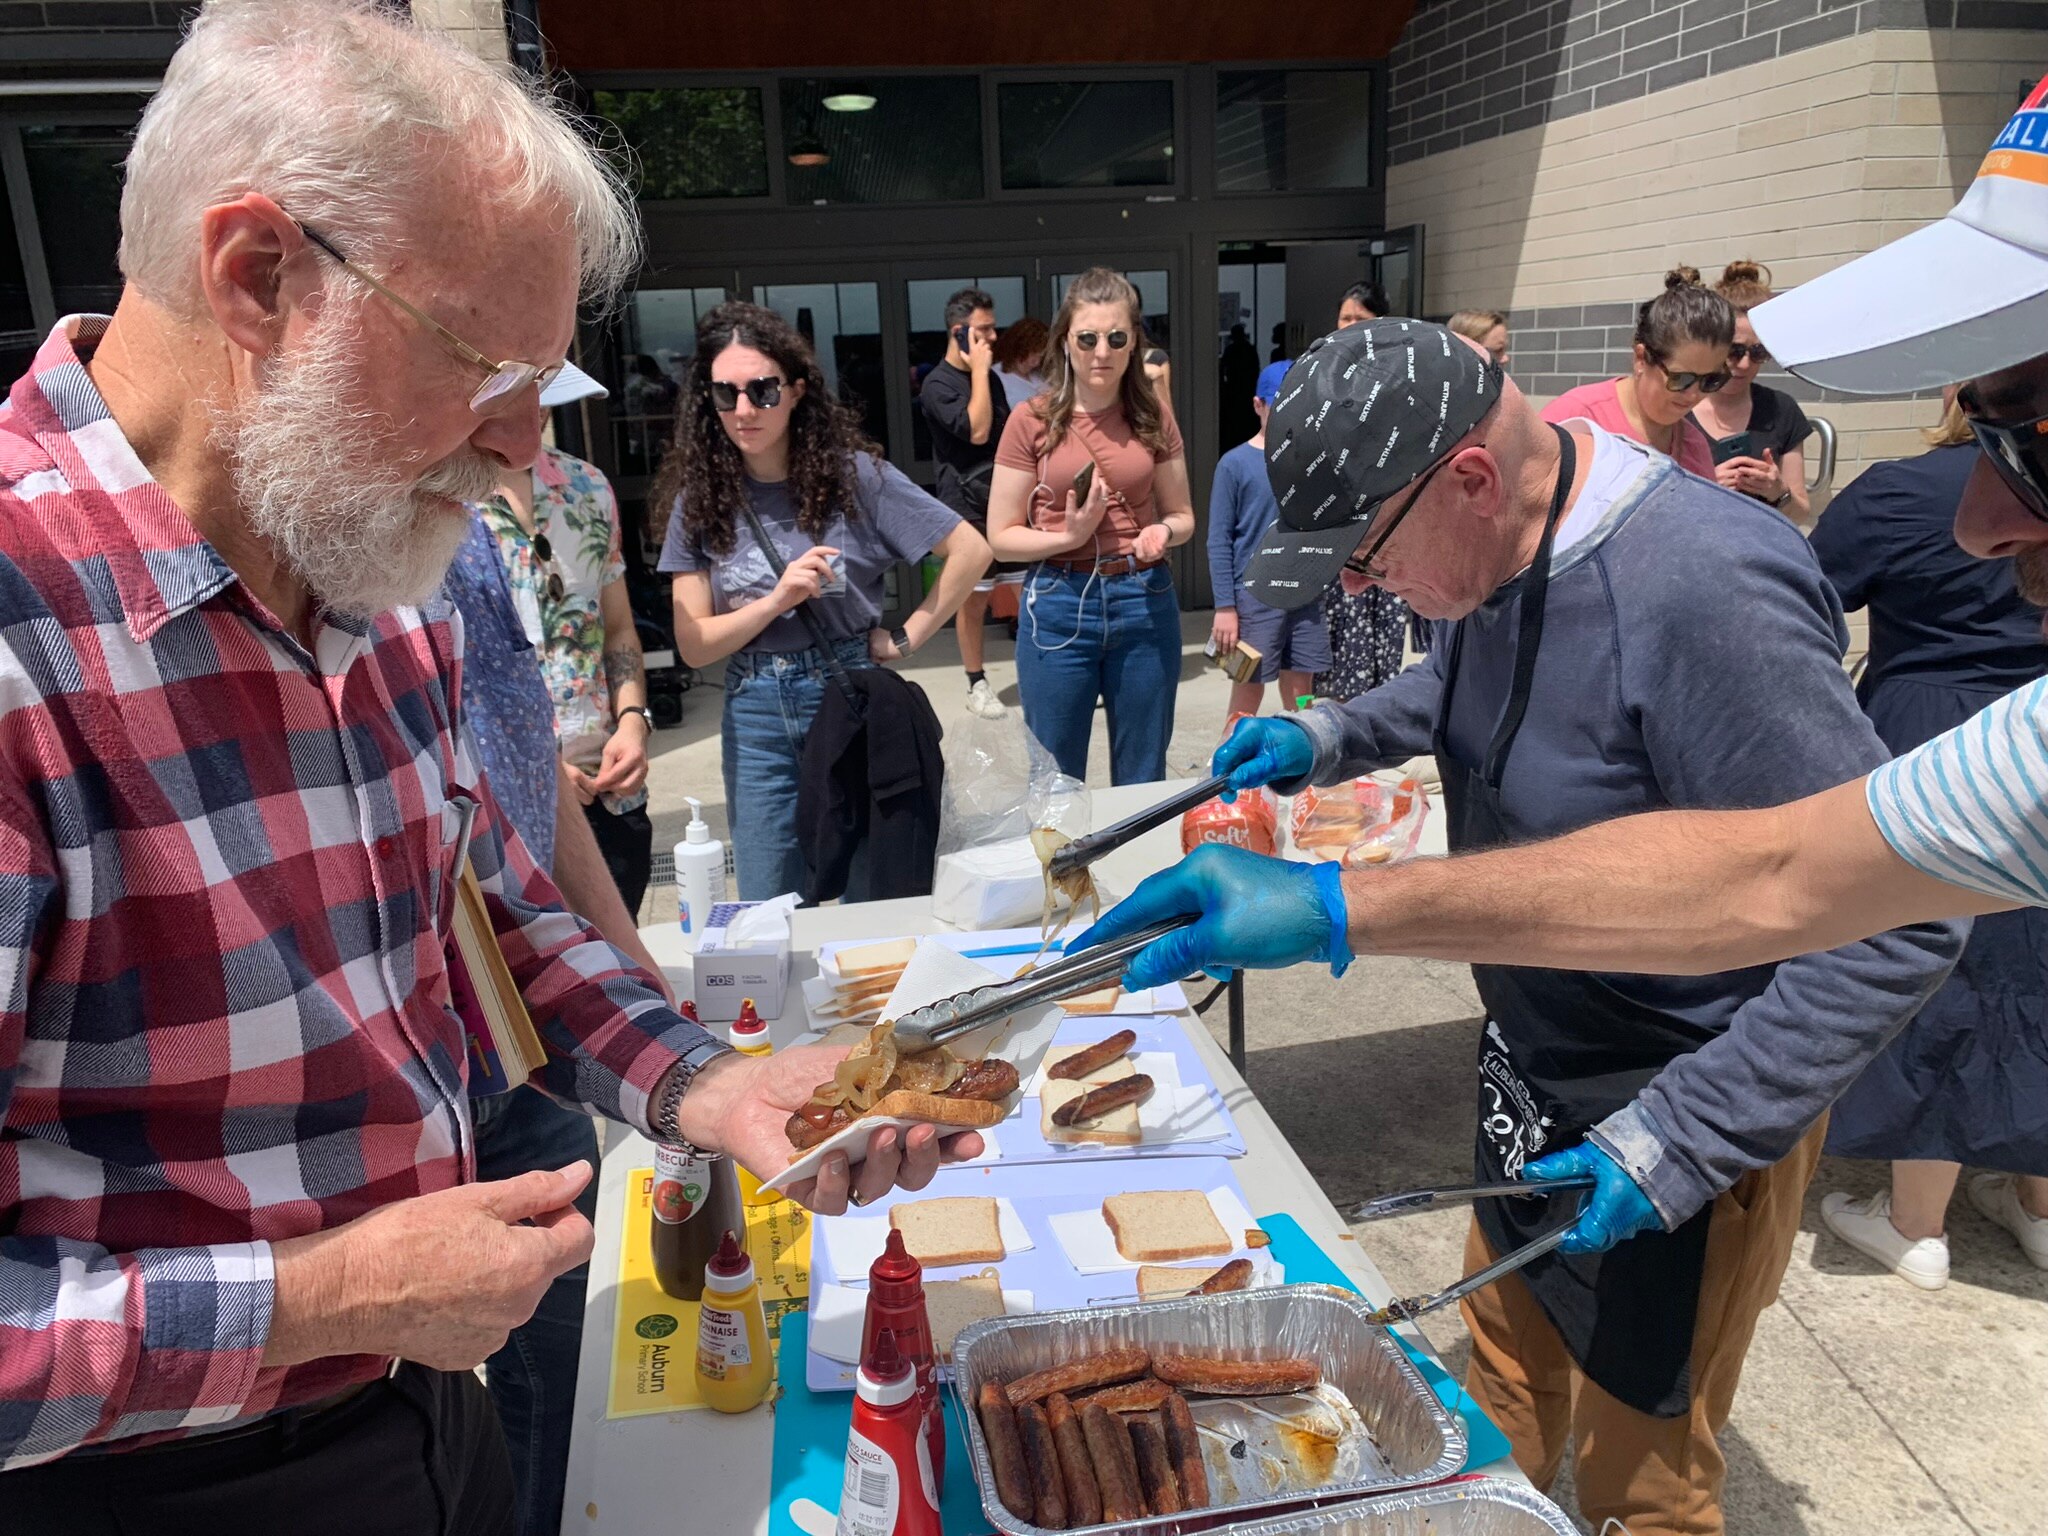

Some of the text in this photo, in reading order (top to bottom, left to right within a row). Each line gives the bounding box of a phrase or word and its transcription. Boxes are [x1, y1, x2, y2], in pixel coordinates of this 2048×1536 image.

[1359, 400, 1373, 422] SIXTH
[1376, 430, 1399, 468] SIXTH JUNE
[1314, 547, 1333, 555] SIXTH
[708, 976, 734, 986] COS
[766, 1205, 778, 1229] ausage
[636, 1344, 650, 1395] Primary School
[650, 1344, 671, 1393] Auburn
[860, 1447, 882, 1462] SAUCE
